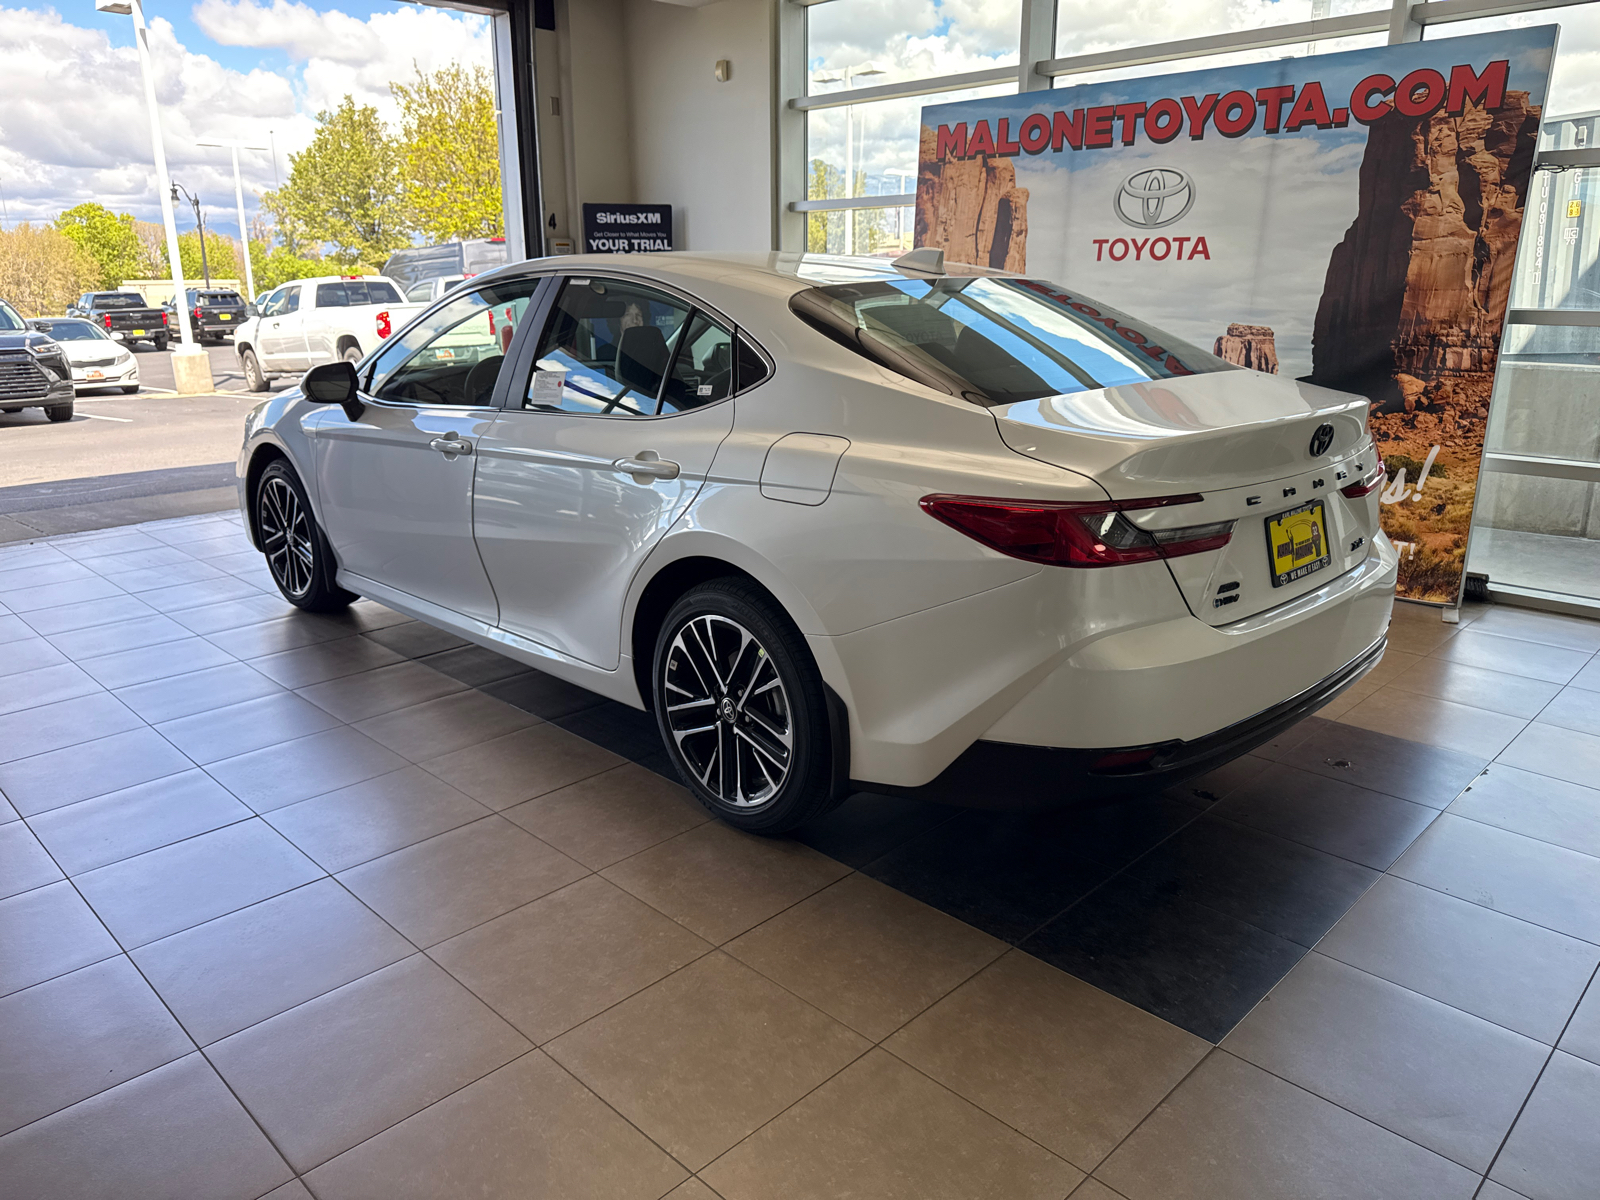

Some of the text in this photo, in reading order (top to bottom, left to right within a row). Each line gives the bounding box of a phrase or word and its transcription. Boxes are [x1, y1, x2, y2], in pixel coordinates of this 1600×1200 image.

[936, 60, 1509, 160] MALONETOYOTA.COM
[548, 213, 557, 230] 4
[596, 212, 661, 224] SiriusXM
[589, 239, 672, 251] YOUR TRIAL
[1092, 236, 1211, 262] TOYOTA
